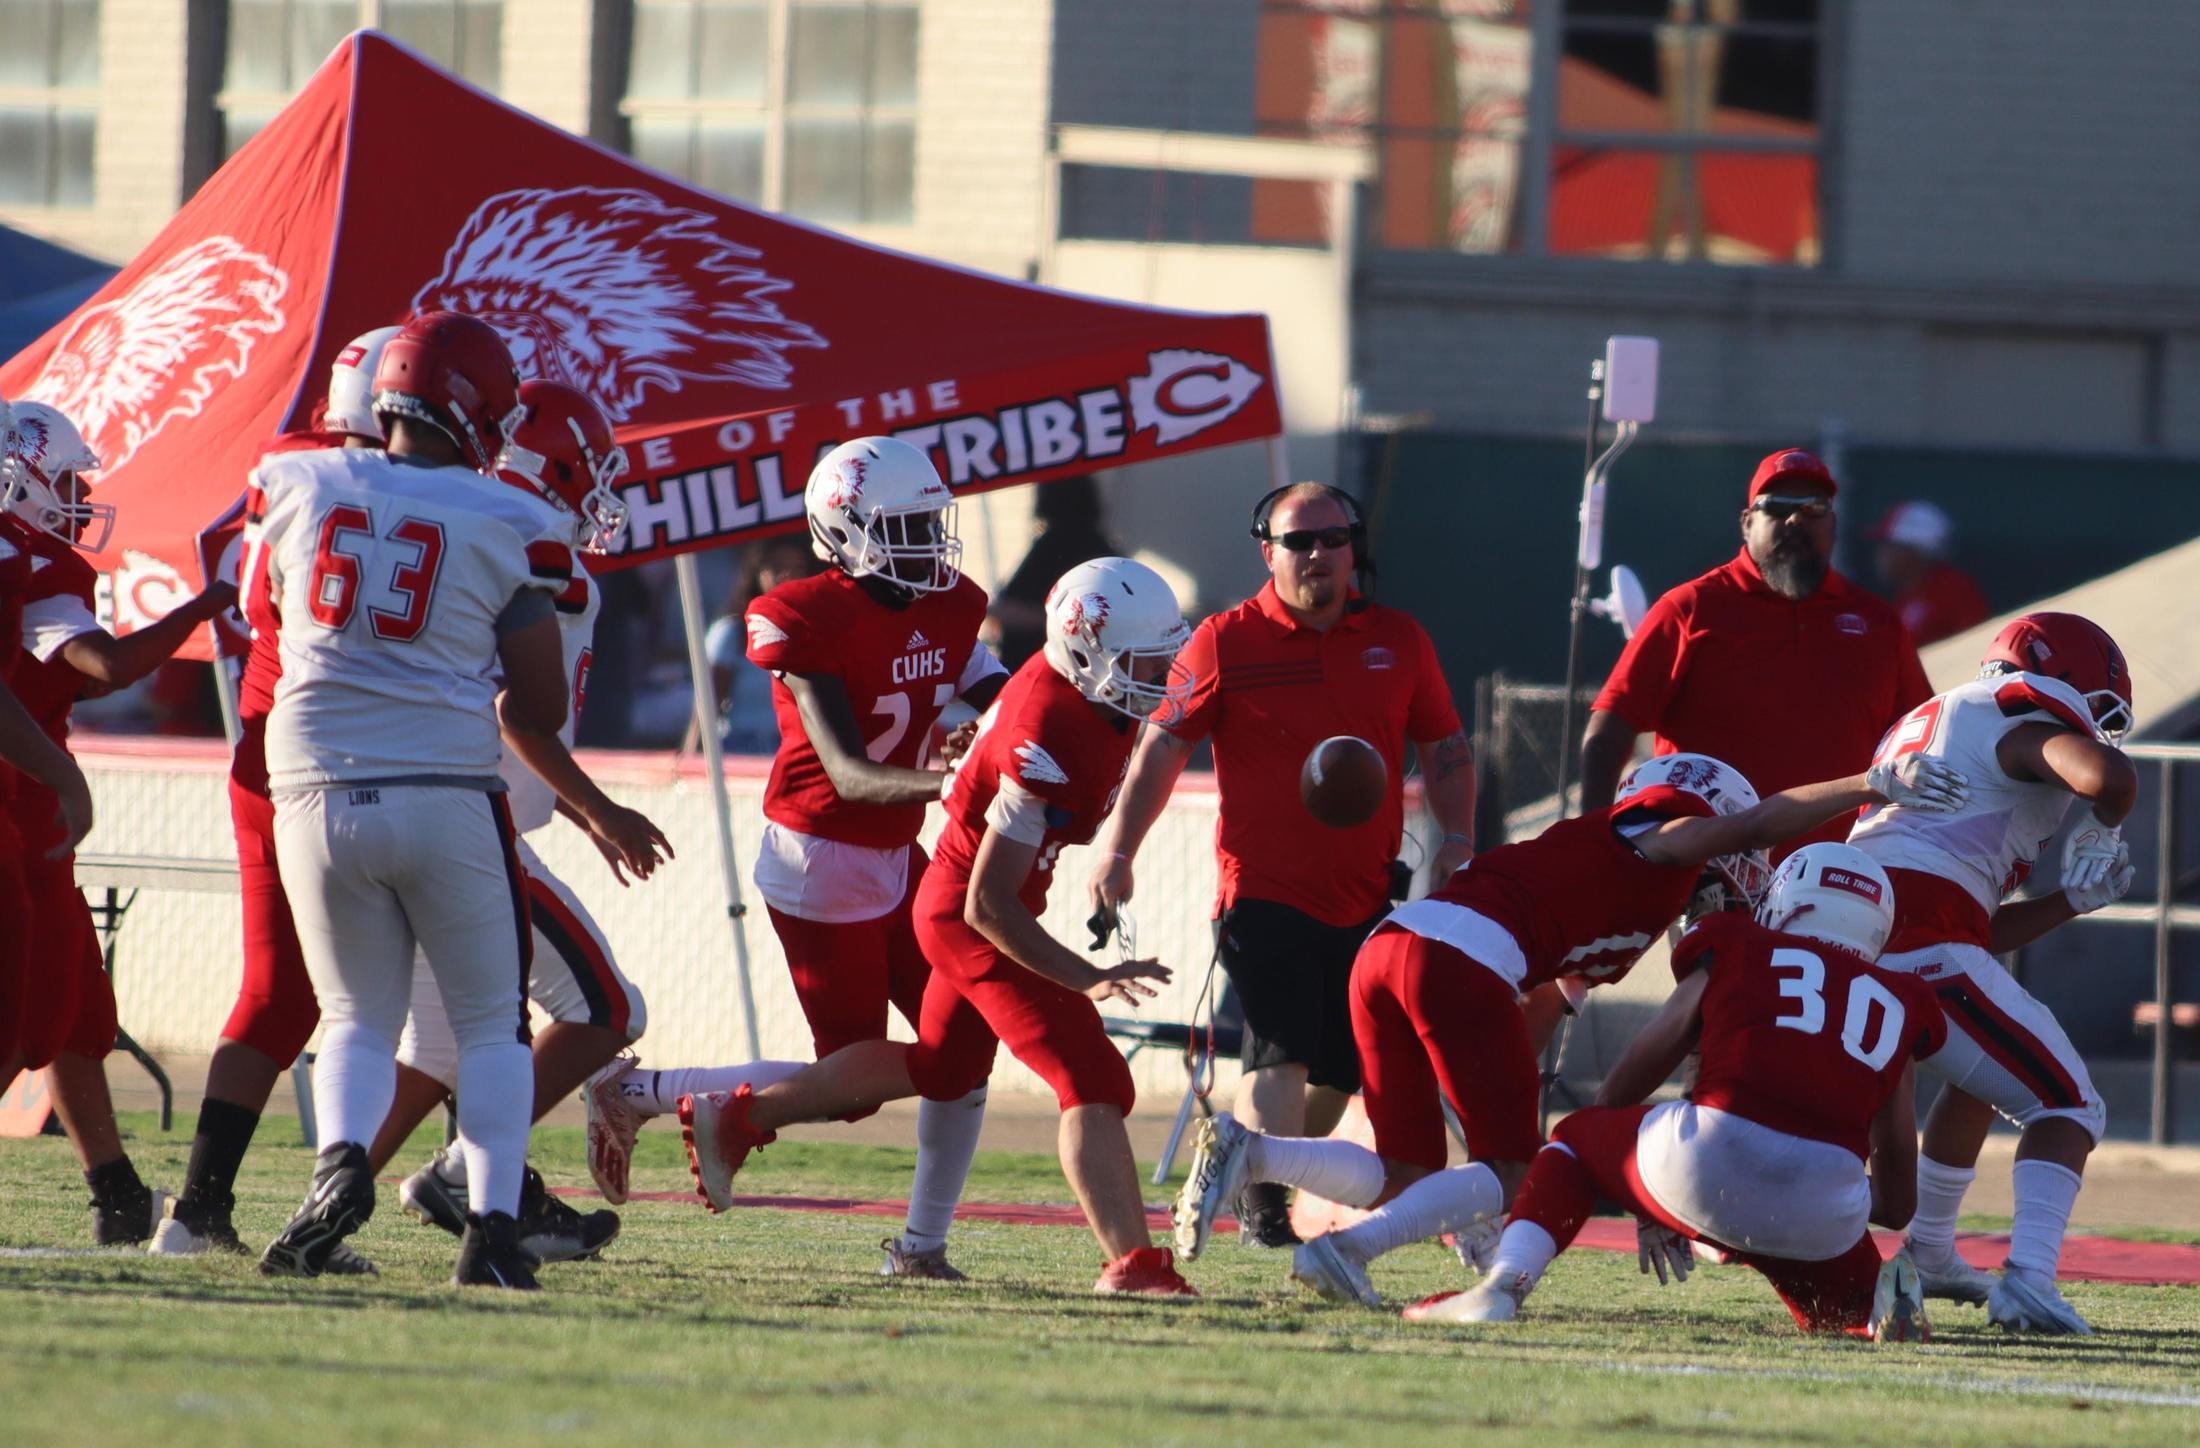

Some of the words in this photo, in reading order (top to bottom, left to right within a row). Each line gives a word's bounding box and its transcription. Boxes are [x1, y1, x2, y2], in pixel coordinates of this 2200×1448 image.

[641, 436, 676, 470] E
[717, 411, 797, 451] OF
[837, 380, 961, 430] THE
[614, 442, 838, 556] HILL
[304, 502, 446, 644] 63
[892, 647, 946, 684] CUHS
[348, 789, 380, 806] LIONS
[1827, 872, 1850, 885] ROLL
[1852, 878, 1878, 895] TRIBE
[1770, 948, 1905, 1072] 30
